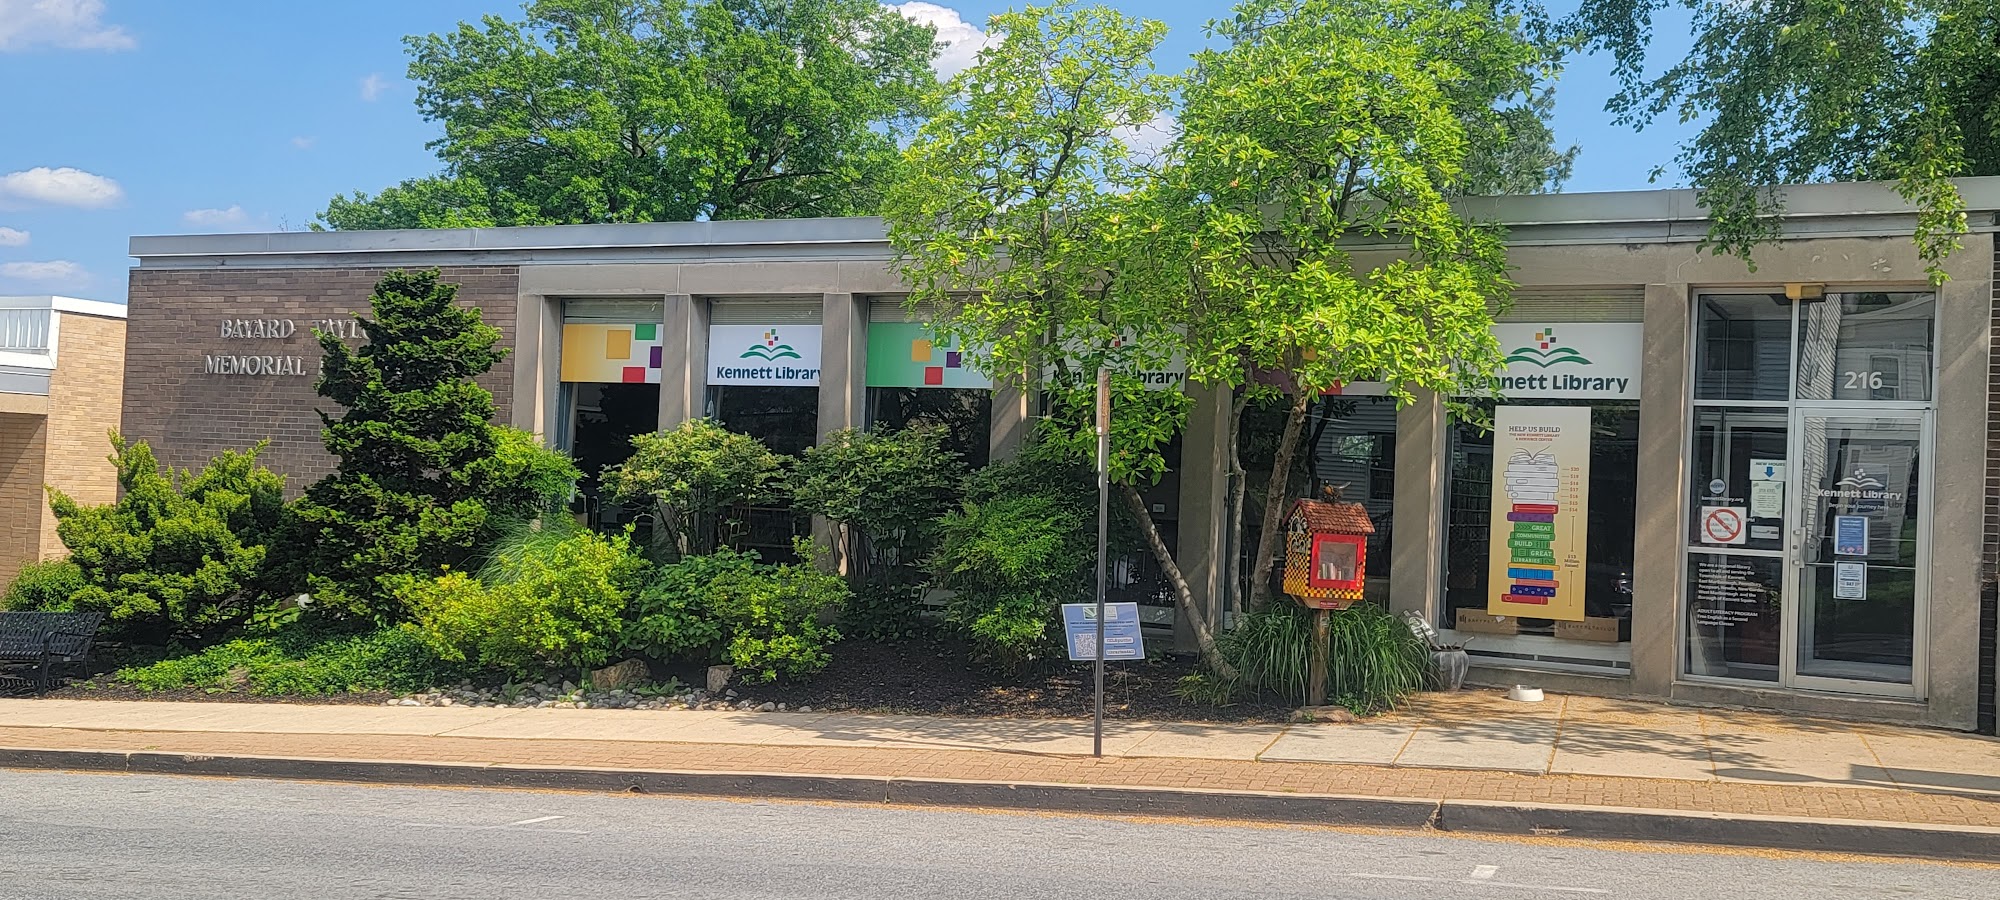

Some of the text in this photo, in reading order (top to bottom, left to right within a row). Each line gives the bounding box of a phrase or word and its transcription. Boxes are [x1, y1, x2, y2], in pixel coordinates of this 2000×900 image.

[220, 318, 295, 339] BAYARD
[204, 354, 307, 376] MEMORIAL
[716, 366, 773, 379] Kennett
[1552, 374, 1629, 393] Library
[1843, 371, 1883, 390] 216
[1817, 488, 1902, 500] Kennett Library
